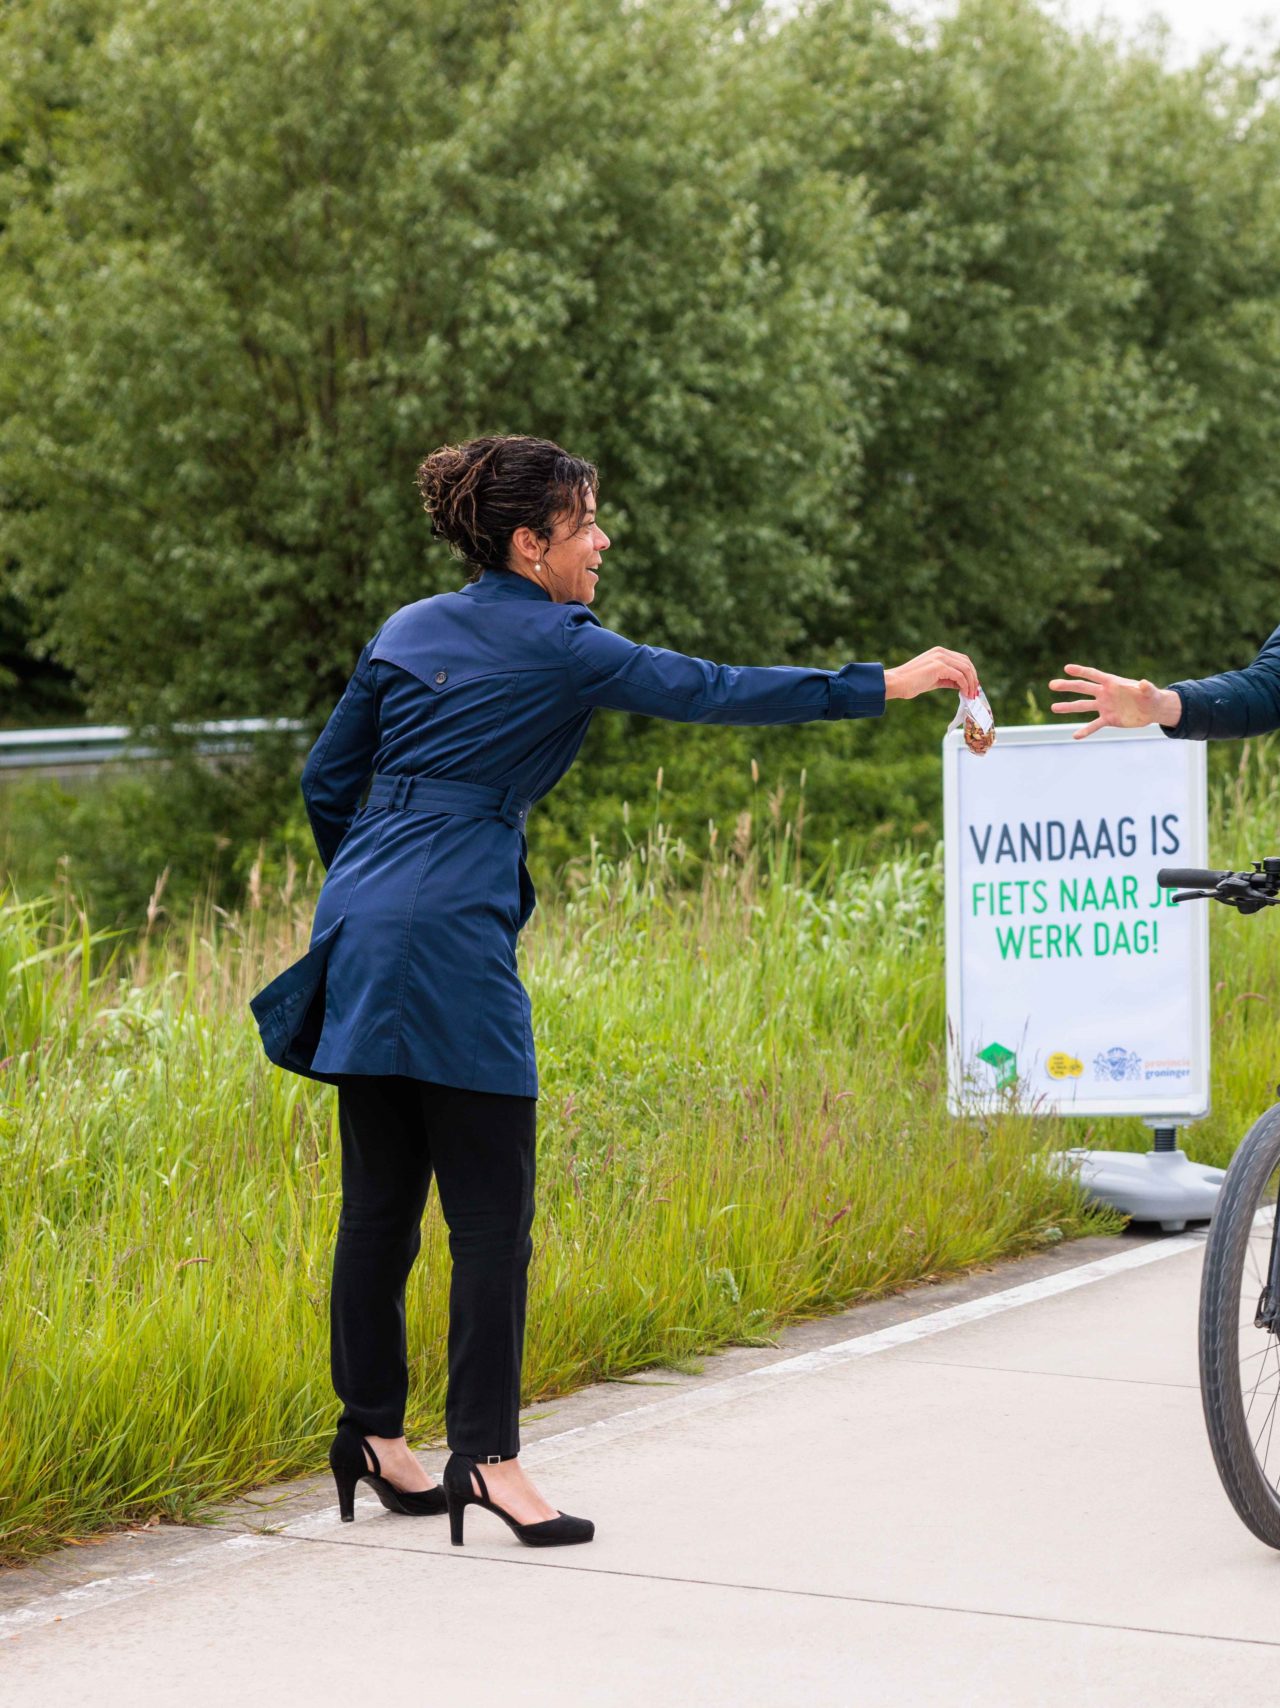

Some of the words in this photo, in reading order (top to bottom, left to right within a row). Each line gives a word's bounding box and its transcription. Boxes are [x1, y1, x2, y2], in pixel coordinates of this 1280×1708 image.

[969, 816, 1137, 864] VANDAAG
[1151, 814, 1180, 856] IS
[972, 879, 1048, 916] FIETS
[1059, 875, 1138, 912] NAAR
[995, 923, 1082, 960] WERK
[1094, 920, 1158, 956] DAG!
